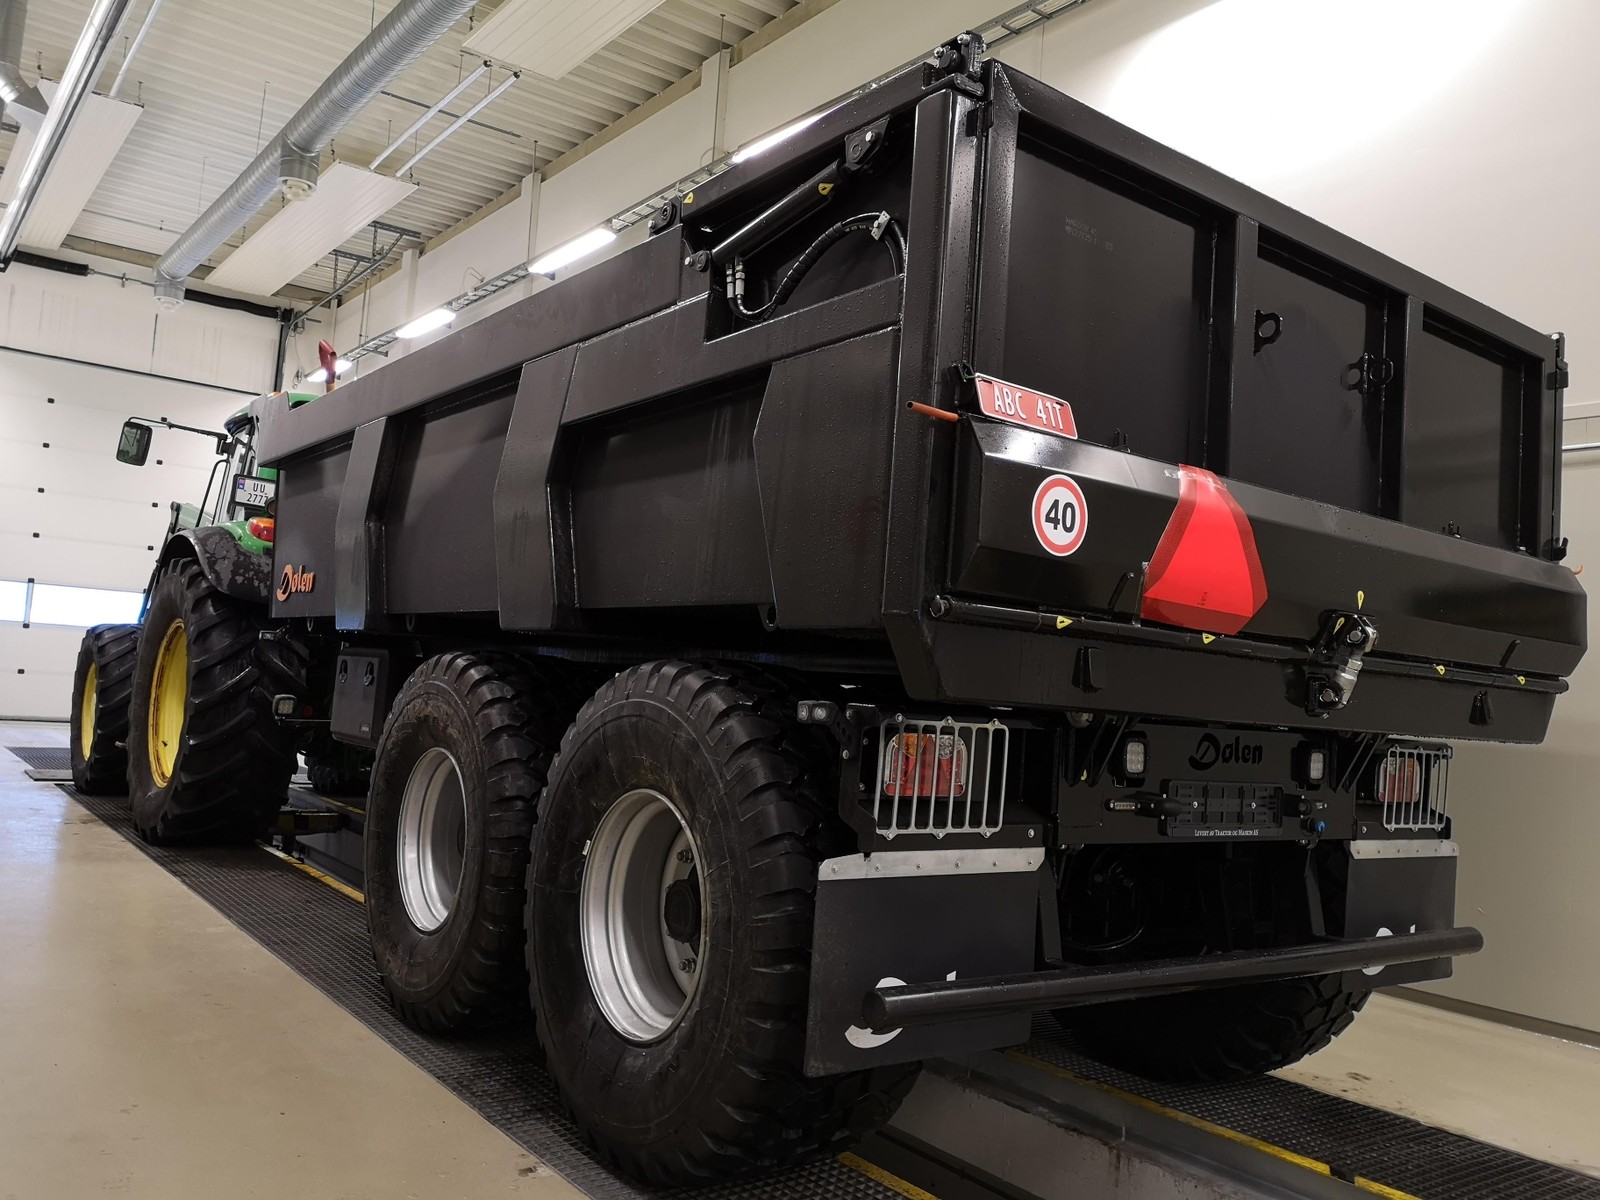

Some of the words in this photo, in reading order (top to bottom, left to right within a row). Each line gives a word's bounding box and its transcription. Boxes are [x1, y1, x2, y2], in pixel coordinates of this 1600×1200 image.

[993, 385, 1027, 420] ABC
[1036, 398, 1064, 430] 41T
[246, 492, 269, 504] 2777
[253, 482, 266, 493] UU
[1044, 499, 1076, 533] 40
